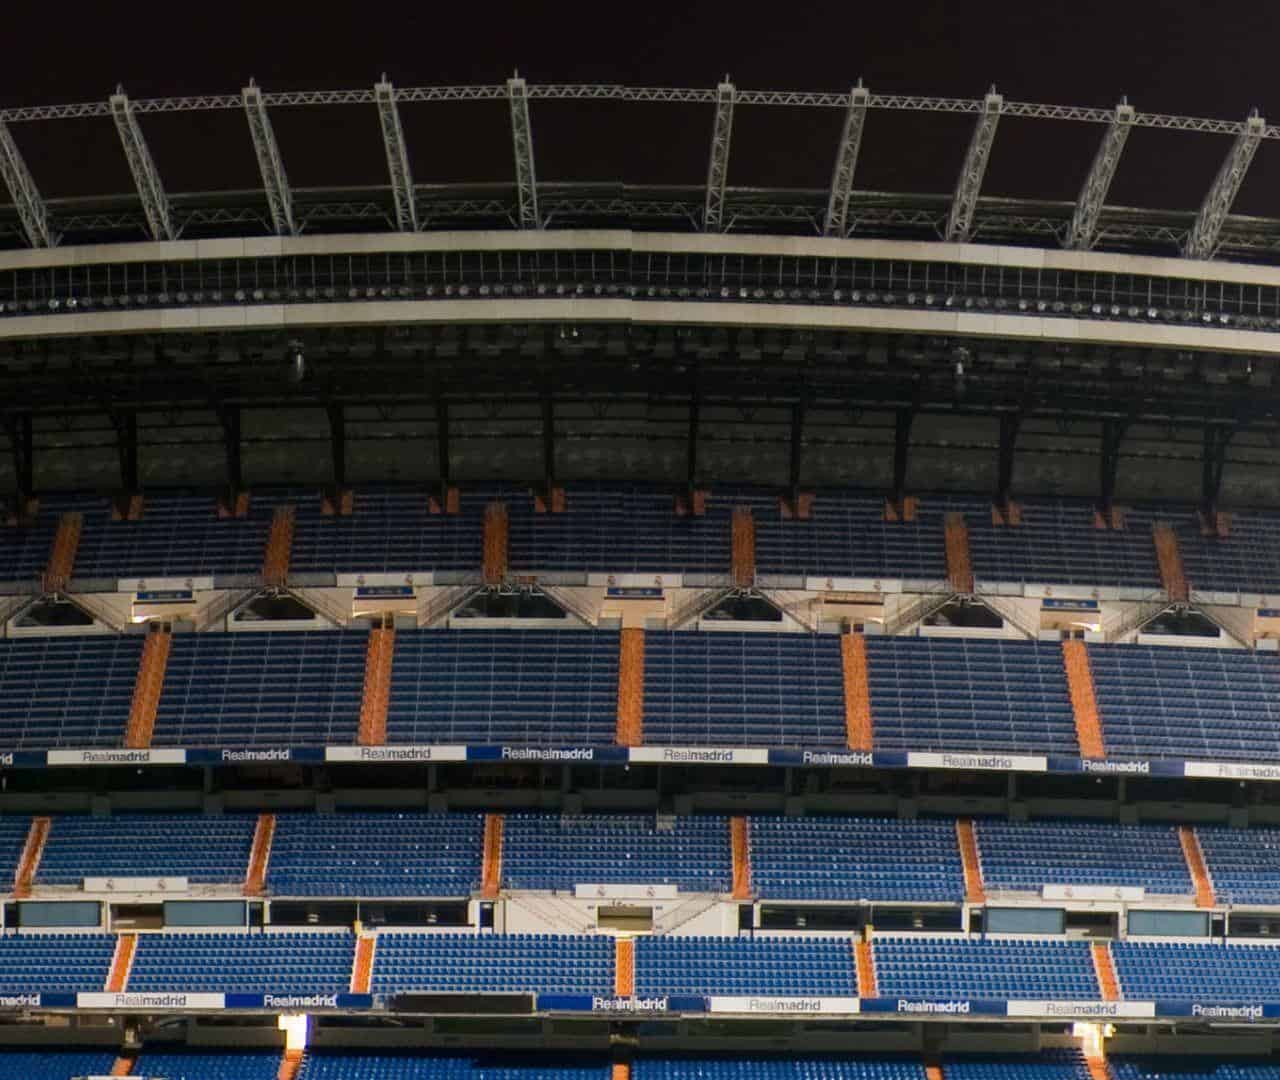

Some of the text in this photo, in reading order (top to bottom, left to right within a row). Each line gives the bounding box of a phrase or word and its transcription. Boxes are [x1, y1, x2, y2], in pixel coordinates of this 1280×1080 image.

[82, 751, 150, 763] Realmadrid
[221, 748, 289, 761] Realmadrid
[360, 747, 431, 760] Realmadrid
[663, 749, 734, 761] Realmadrid
[803, 751, 873, 765] Realmadrid
[1082, 758, 1150, 773] Realmadrid
[115, 995, 187, 1007] Realmadrid
[263, 995, 337, 1008] Realmadrid
[748, 999, 821, 1011] Realmadrid
[897, 1000, 970, 1014] Realmadrid
[1046, 1003, 1117, 1015] Realmadrid
[1191, 1004, 1264, 1018] Realmadrid
